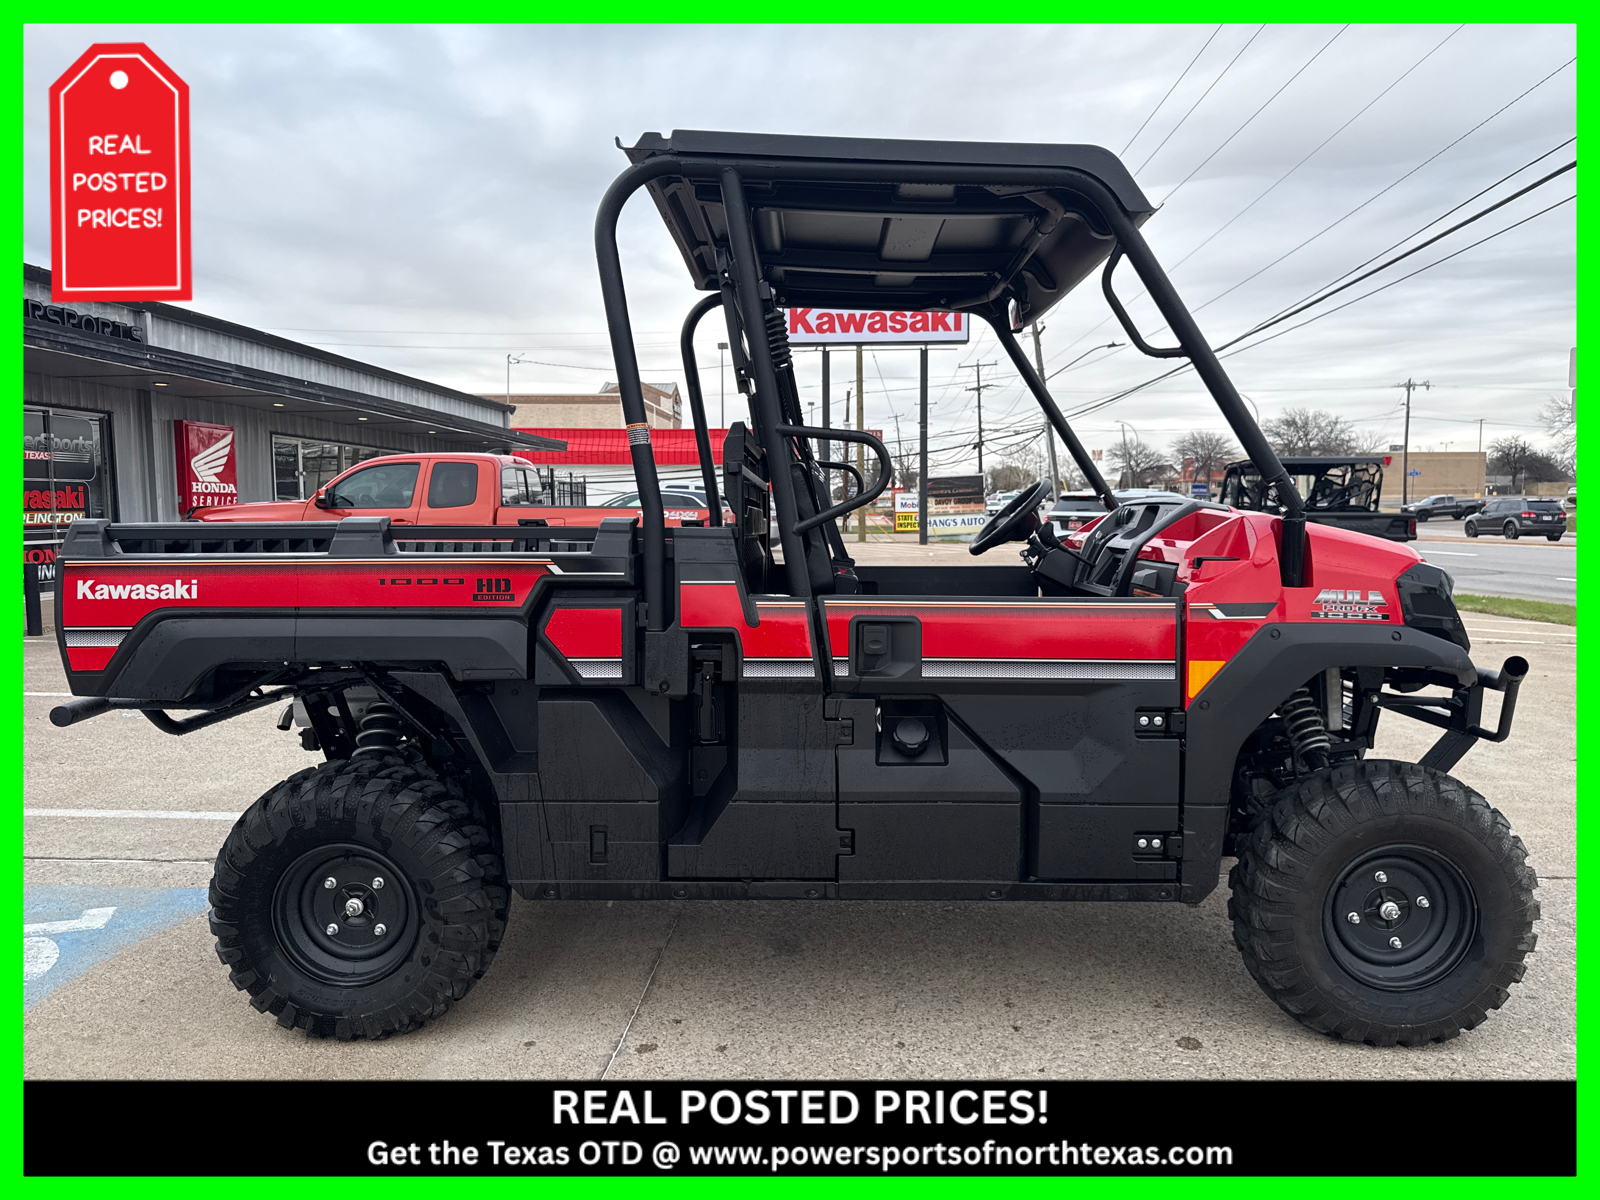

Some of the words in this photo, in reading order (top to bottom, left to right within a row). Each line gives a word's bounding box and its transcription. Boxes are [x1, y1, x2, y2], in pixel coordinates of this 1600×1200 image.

[789, 307, 962, 334] Kawasaki
[191, 482, 238, 494] HONDA
[192, 495, 238, 507] SERVICE
[897, 514, 914, 522] STATE
[960, 517, 986, 526] AUTO
[77, 579, 198, 600] Kawasaki
[378, 578, 465, 586] 1000
[476, 578, 511, 593] HD
[1312, 588, 1388, 606] MULE
[1318, 611, 1383, 620] 1000
